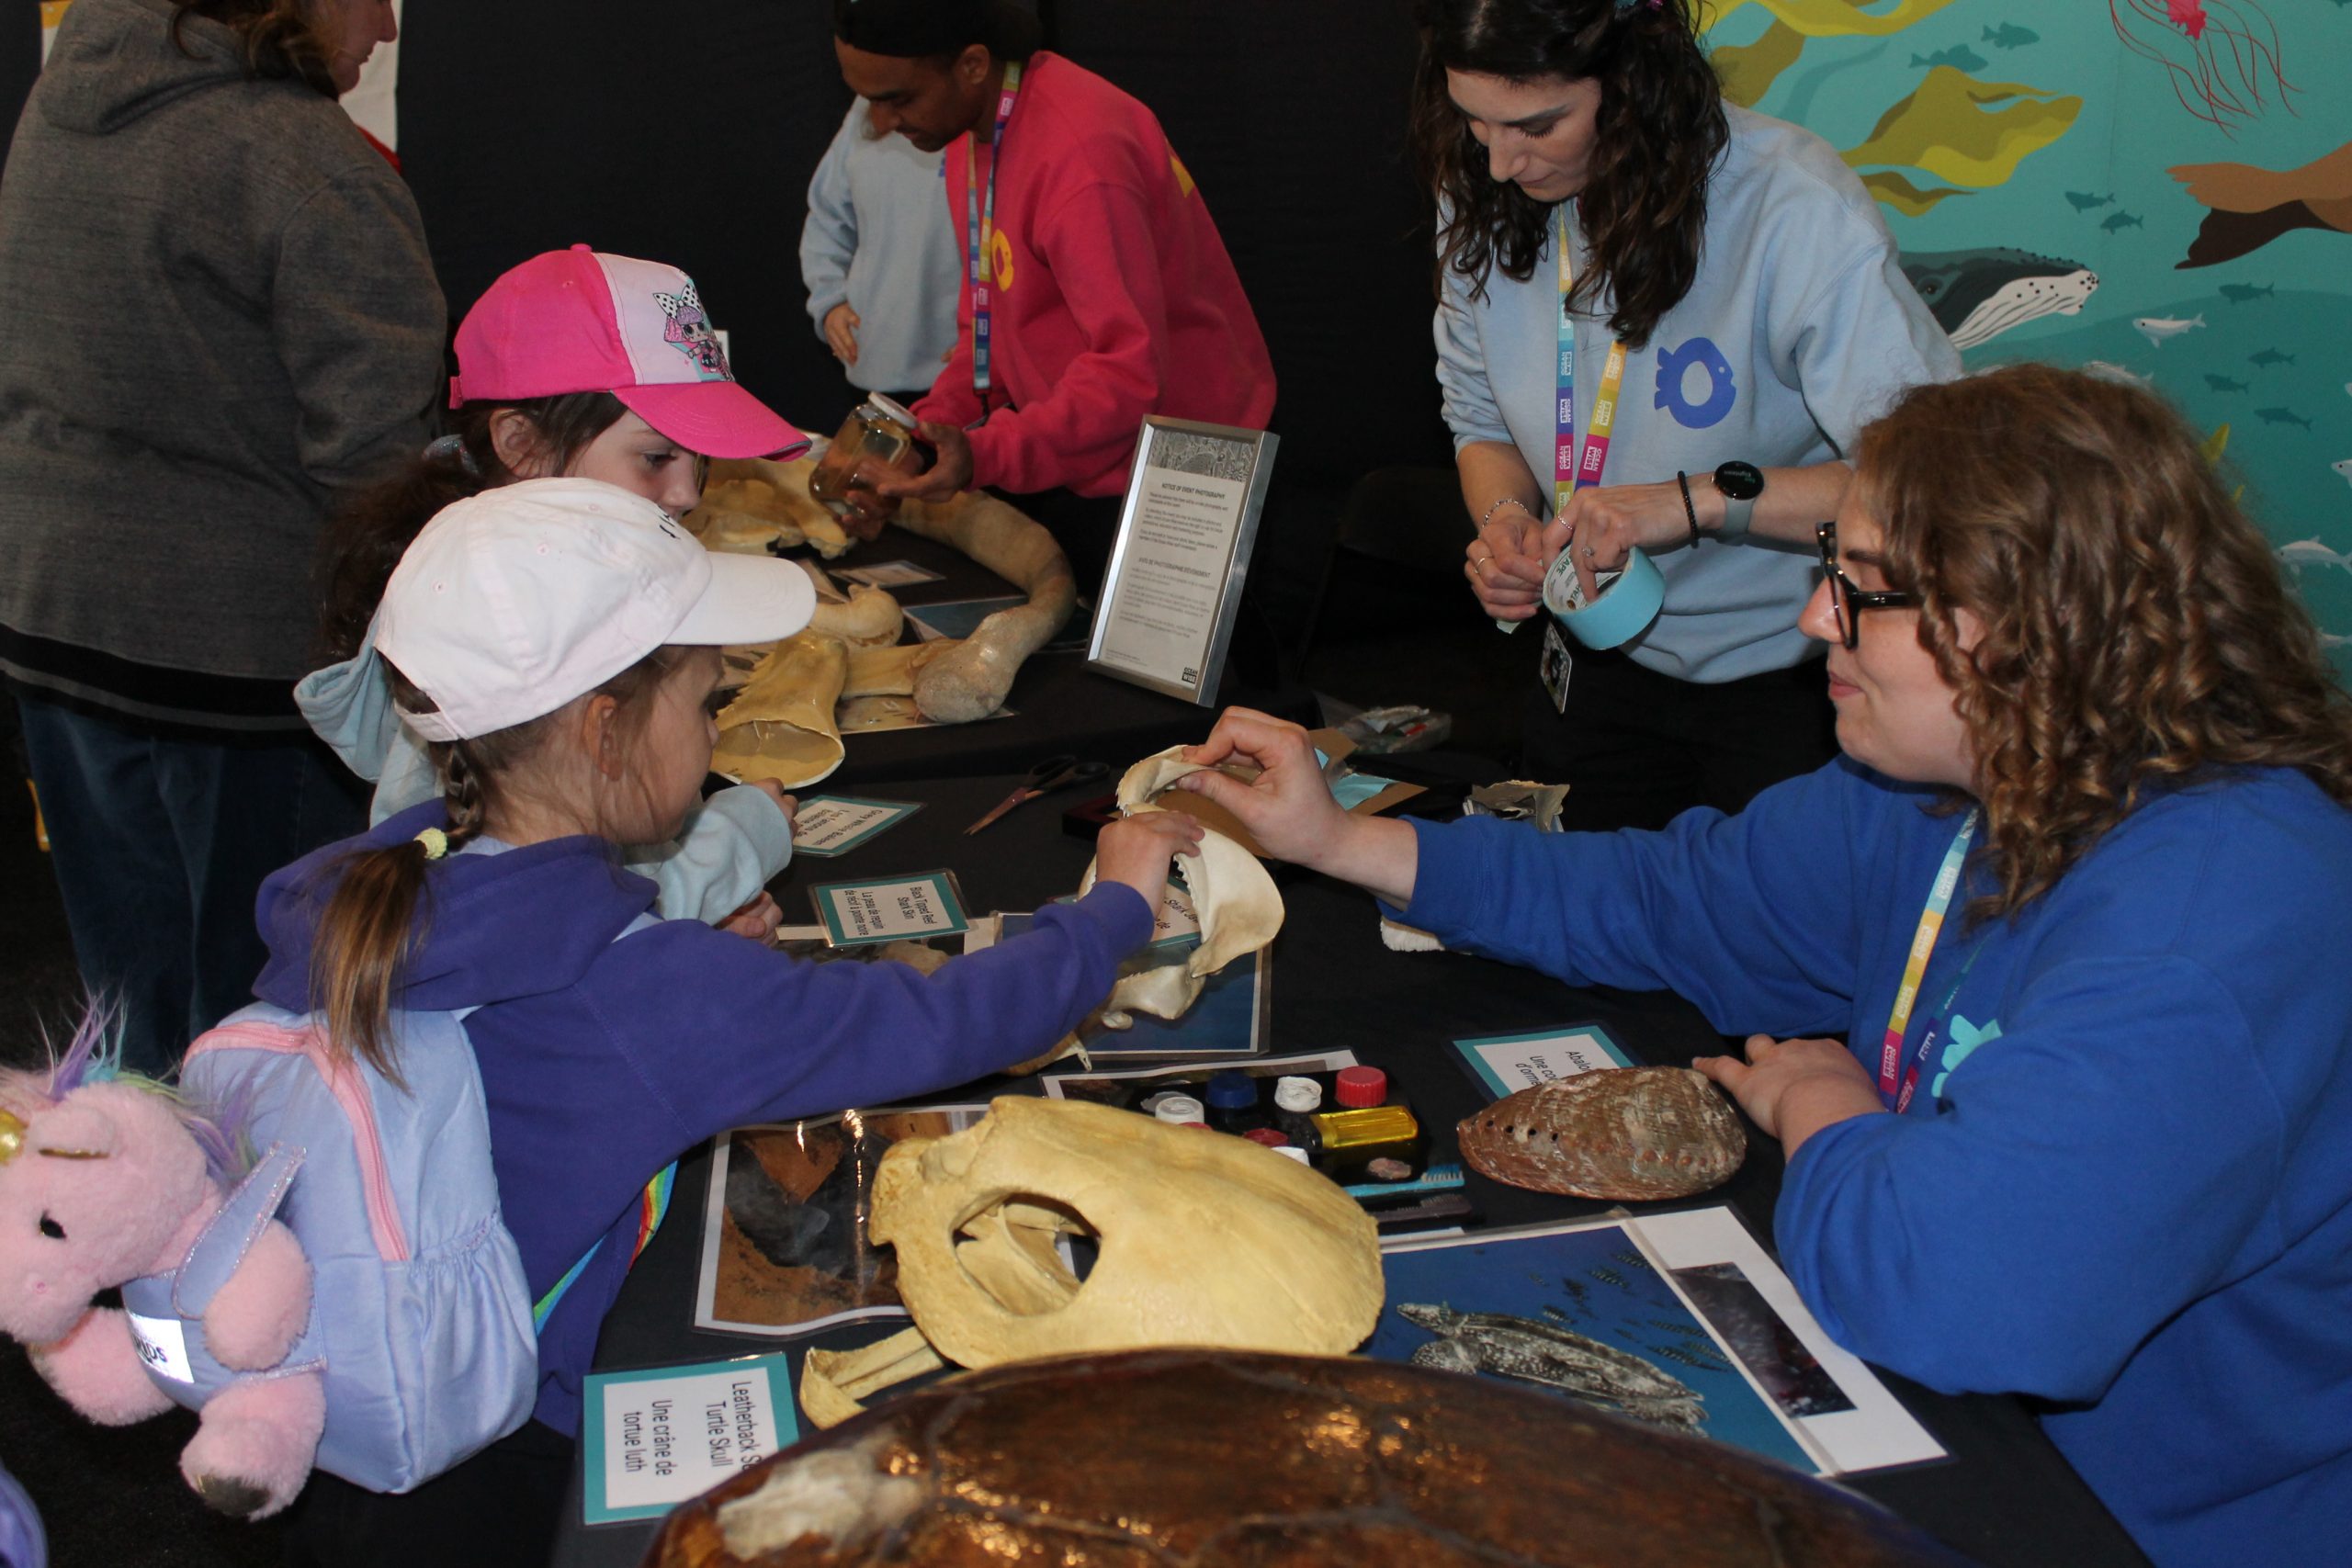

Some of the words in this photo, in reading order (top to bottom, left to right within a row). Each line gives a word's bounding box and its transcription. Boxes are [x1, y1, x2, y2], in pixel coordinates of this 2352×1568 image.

[897, 897, 912, 908] Shark
[910, 886, 925, 898] Black
[862, 897, 876, 908] peau
[870, 915, 886, 930] requin
[902, 909, 916, 919] Skin
[914, 899, 933, 914] Tipped
[849, 909, 865, 923] pointe
[857, 924, 869, 935] noire
[922, 914, 938, 924] Reef
[1530, 1055, 1548, 1070] Une
[651, 1399, 673, 1422] Une
[706, 1401, 730, 1436] Turtle
[731, 1381, 762, 1452] Leatherback
[623, 1411, 644, 1447] tortue
[652, 1424, 676, 1458] crâne
[709, 1437, 734, 1467] Skull
[626, 1449, 647, 1472] luth
[655, 1461, 678, 1476] de
